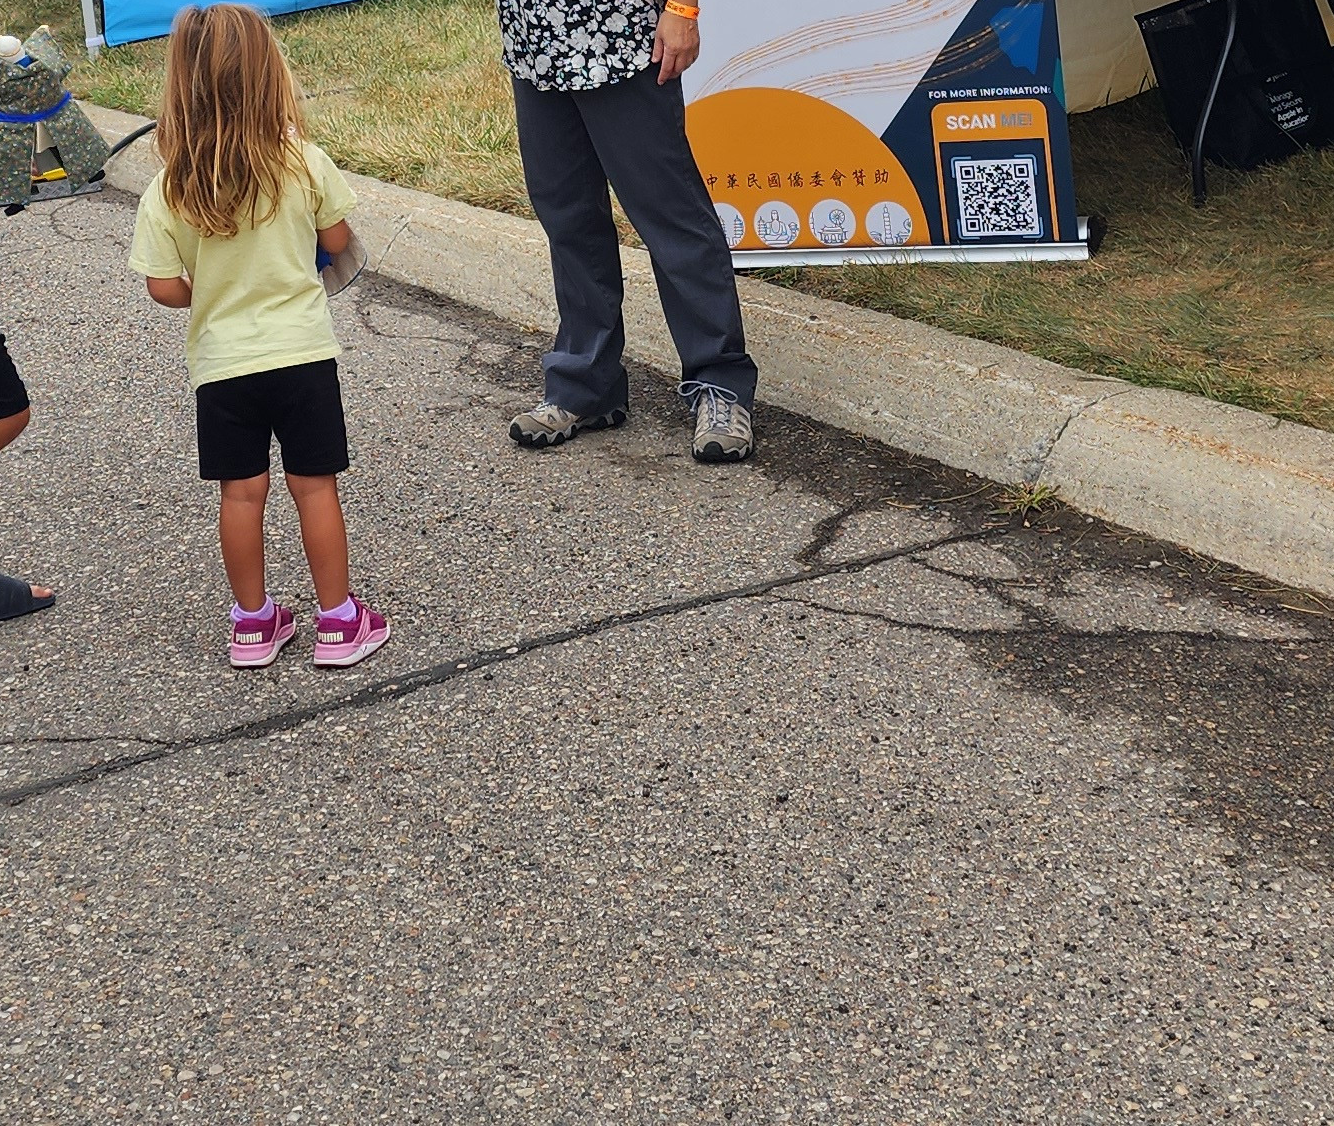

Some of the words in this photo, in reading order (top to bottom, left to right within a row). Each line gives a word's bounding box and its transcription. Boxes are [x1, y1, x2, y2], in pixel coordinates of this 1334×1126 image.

[929, 90, 948, 99] FOR
[949, 88, 978, 99] MORE
[979, 86, 1051, 98] INFORMATION:
[946, 114, 996, 131] SCAN
[1001, 112, 1033, 128] ME!
[1277, 109, 1297, 122] Apple
[706, 168, 889, 191] 中華民國僑委會贊助
[235, 631, 263, 643] PUMA
[317, 631, 344, 643] PUMA
